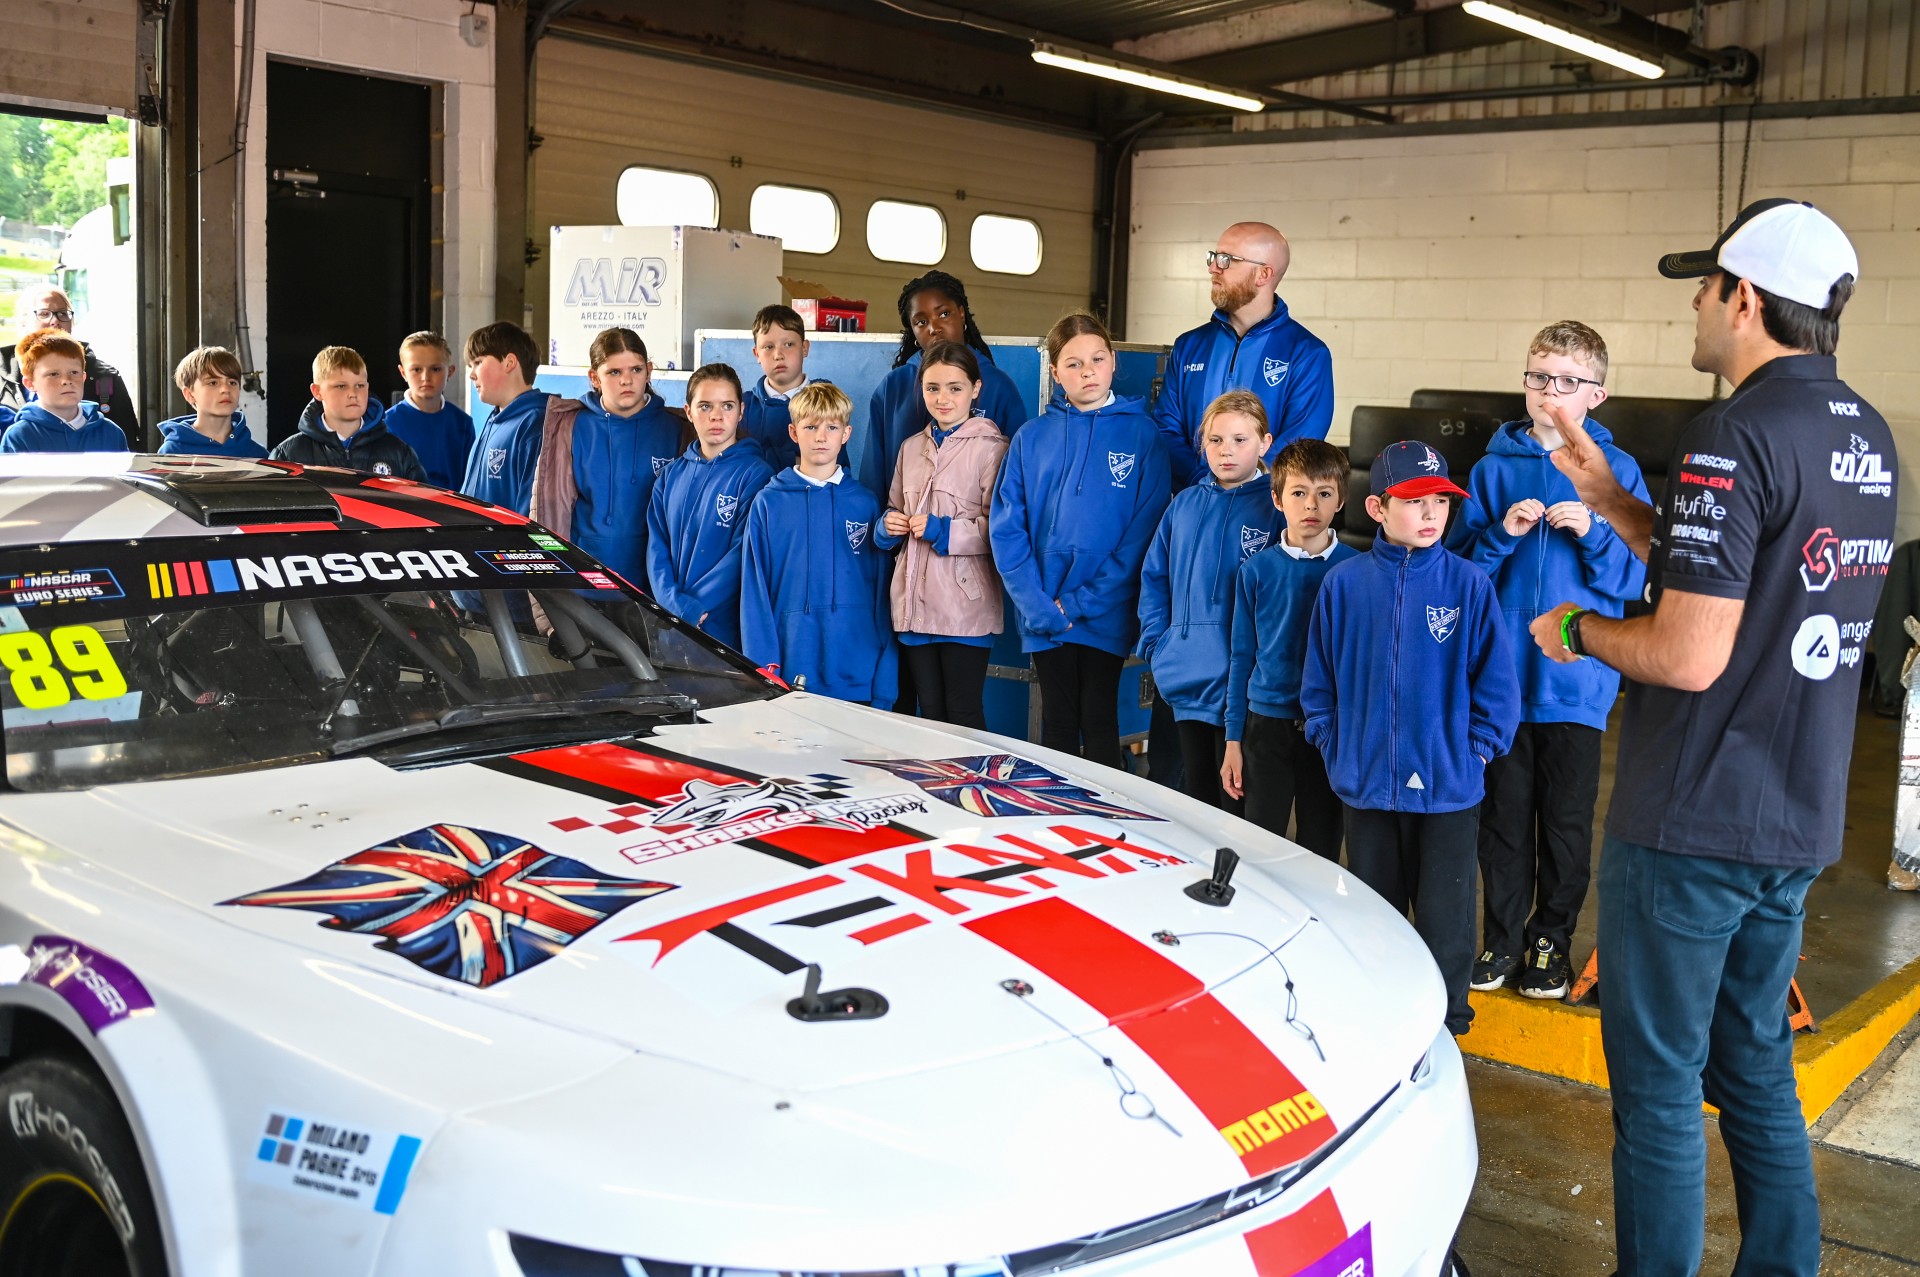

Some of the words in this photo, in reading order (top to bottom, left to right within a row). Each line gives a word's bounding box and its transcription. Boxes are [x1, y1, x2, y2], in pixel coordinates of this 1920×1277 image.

[580, 312, 615, 320] AREZZO
[623, 312, 648, 320] ITALY
[1828, 401, 1861, 417] HRX
[1440, 418, 1465, 436] 89
[1692, 453, 1738, 472] NASCAR
[1859, 483, 1891, 498] racing
[507, 552, 546, 560] NASCAR
[236, 549, 480, 591] NASCAR
[503, 563, 529, 571] EURO
[529, 563, 561, 571] SERIES
[30, 573, 91, 588] NASCAR
[13, 590, 54, 603] EURO
[55, 586, 104, 600] SERIES
[0, 625, 128, 710] 89
[846, 800, 929, 827] Racing
[306, 1123, 371, 1156] MILANO
[298, 1148, 350, 1180] PAGHE
